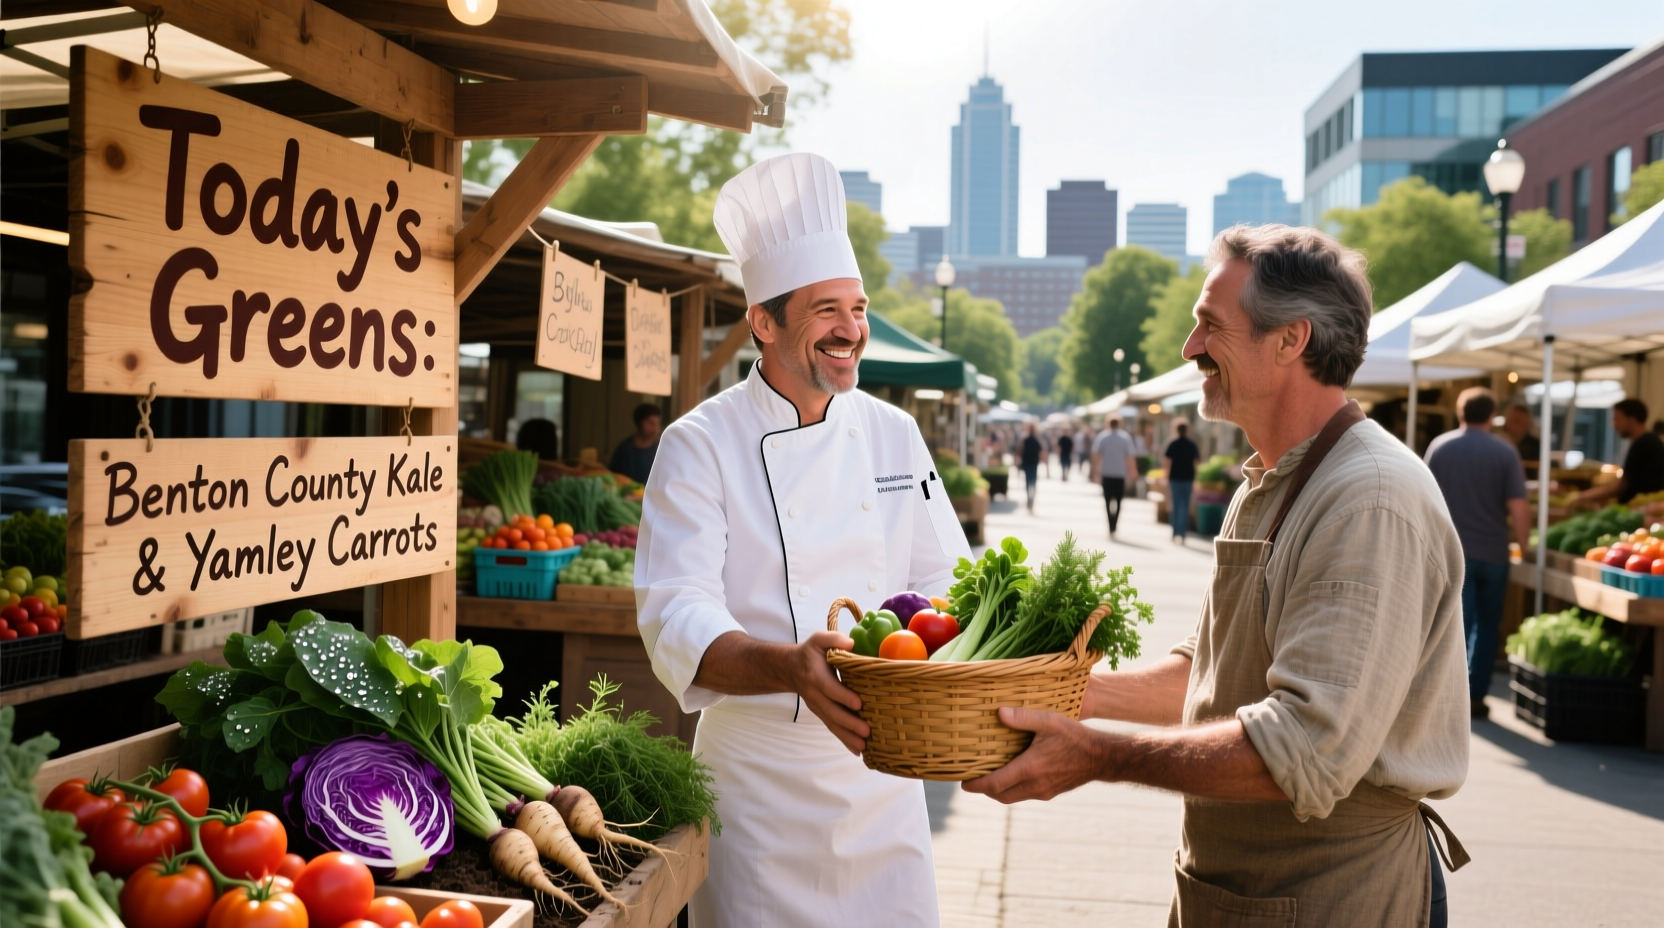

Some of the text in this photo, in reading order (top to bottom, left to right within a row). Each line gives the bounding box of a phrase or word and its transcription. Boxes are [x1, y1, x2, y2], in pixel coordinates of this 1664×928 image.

[139, 104, 422, 292] Today's
[150, 247, 436, 379] Greens:
[104, 451, 443, 526] Benton County Kale
[132, 512, 437, 596] & Yamley Carrots
